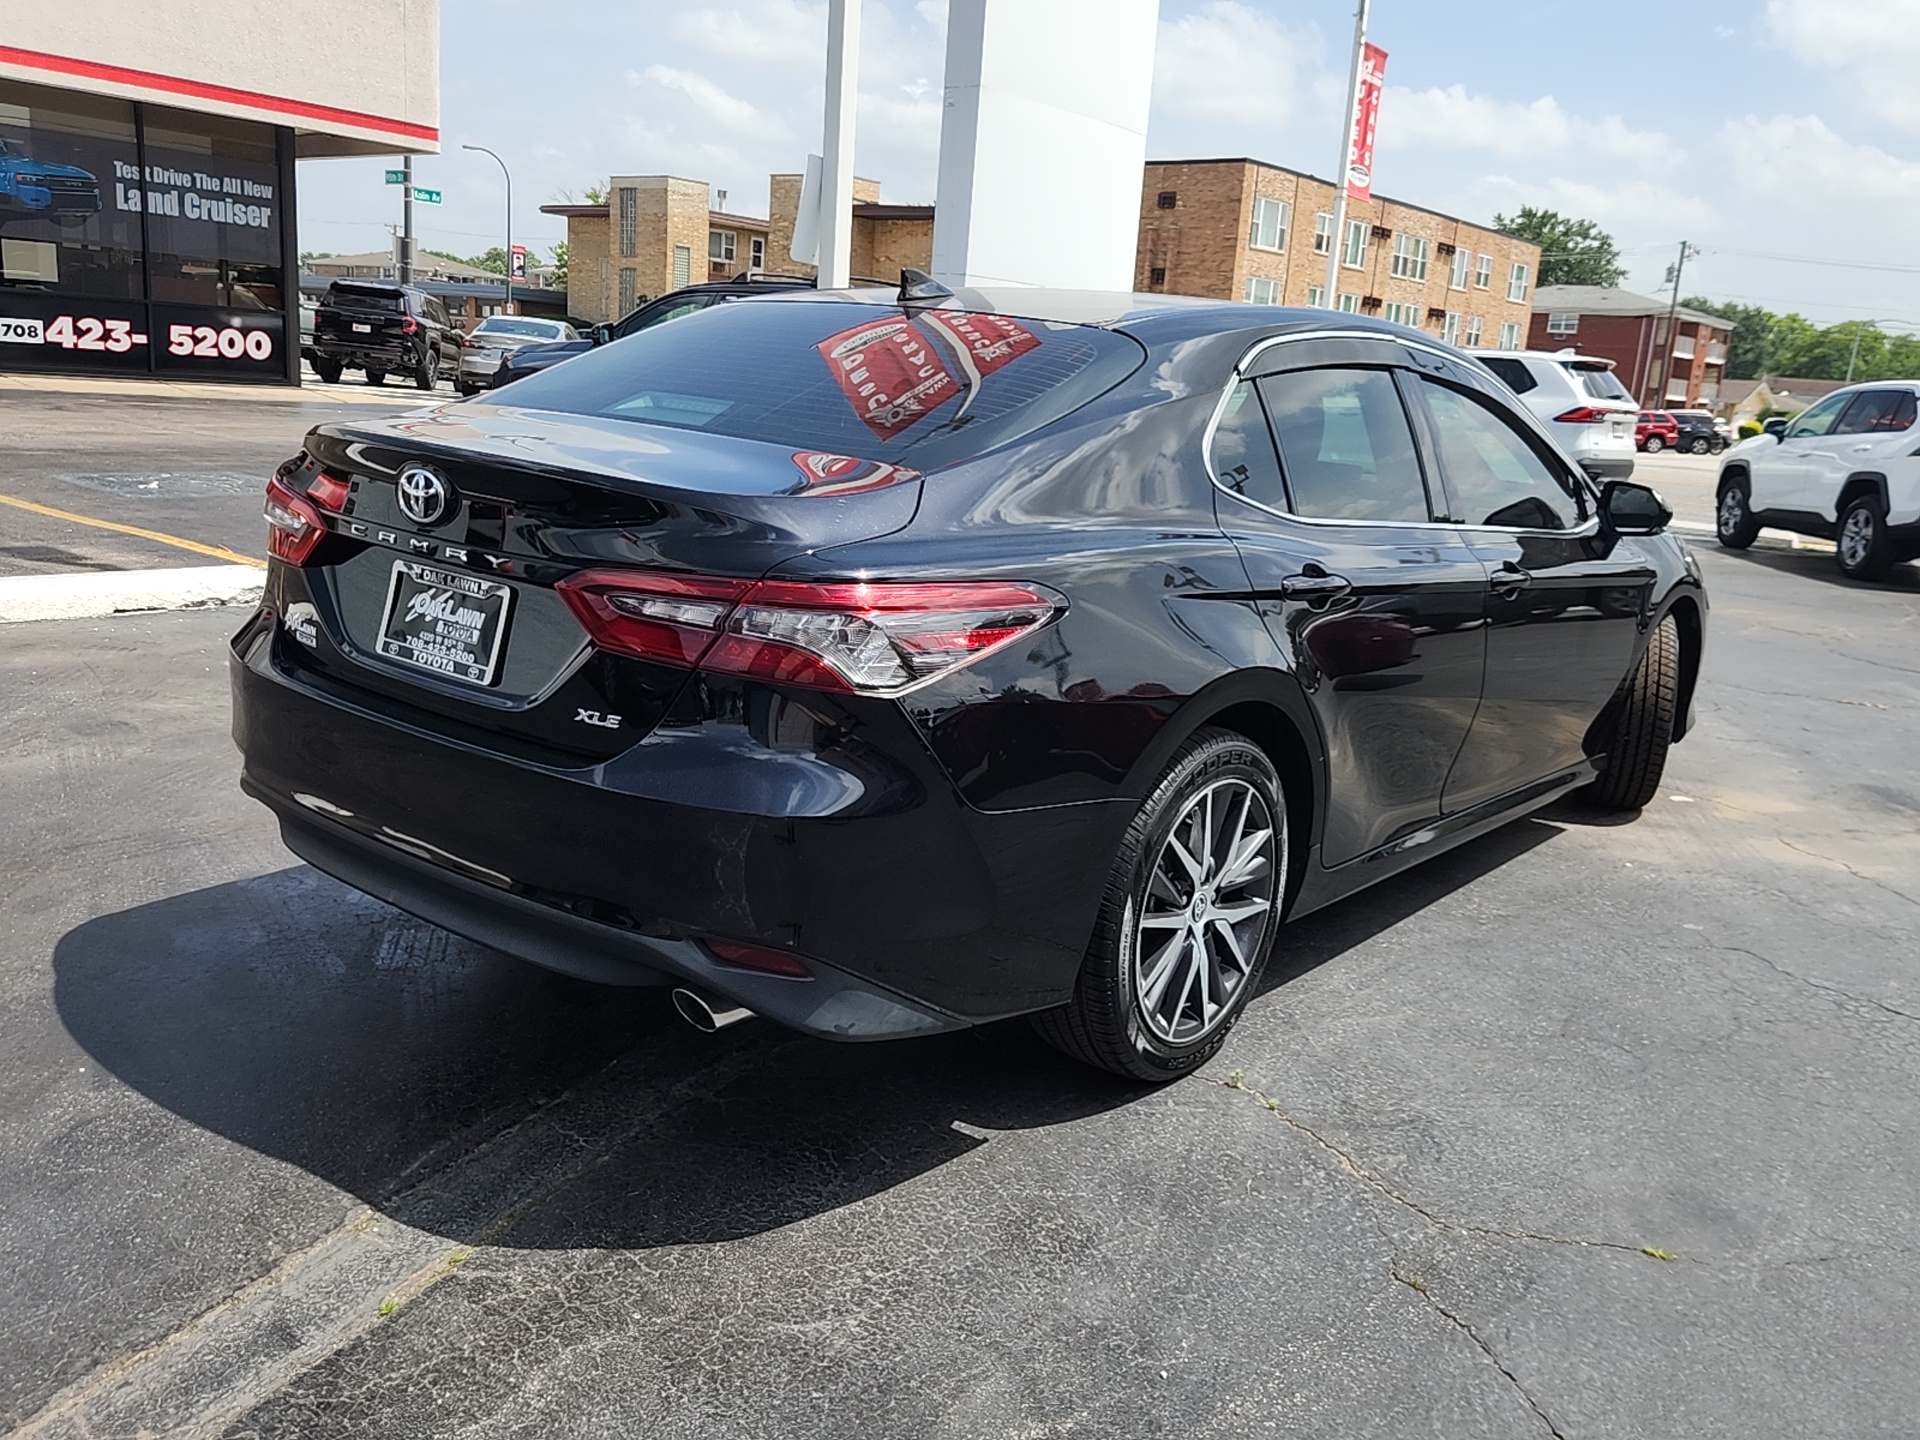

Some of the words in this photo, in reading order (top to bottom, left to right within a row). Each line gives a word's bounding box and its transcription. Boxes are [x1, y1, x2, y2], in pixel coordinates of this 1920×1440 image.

[1364, 91, 1378, 166] CARS
[114, 160, 152, 182] Test
[154, 166, 192, 188] Drive
[194, 172, 222, 192] The
[222, 176, 242, 195] All
[244, 180, 273, 200] New
[116, 183, 180, 217] Land
[184, 192, 272, 228] Cruiser
[1, 324, 39, 338] 708
[46, 316, 148, 352] 423-
[168, 324, 272, 361] 5200
[351, 524, 510, 569] CAMRY
[423, 570, 445, 586] OAK
[447, 575, 479, 593] LAWN
[406, 635, 475, 663] 708-423-5200
[442, 622, 475, 643] TOYOTA
[412, 650, 455, 672] TOYOTA
[574, 708, 622, 729] XLE
